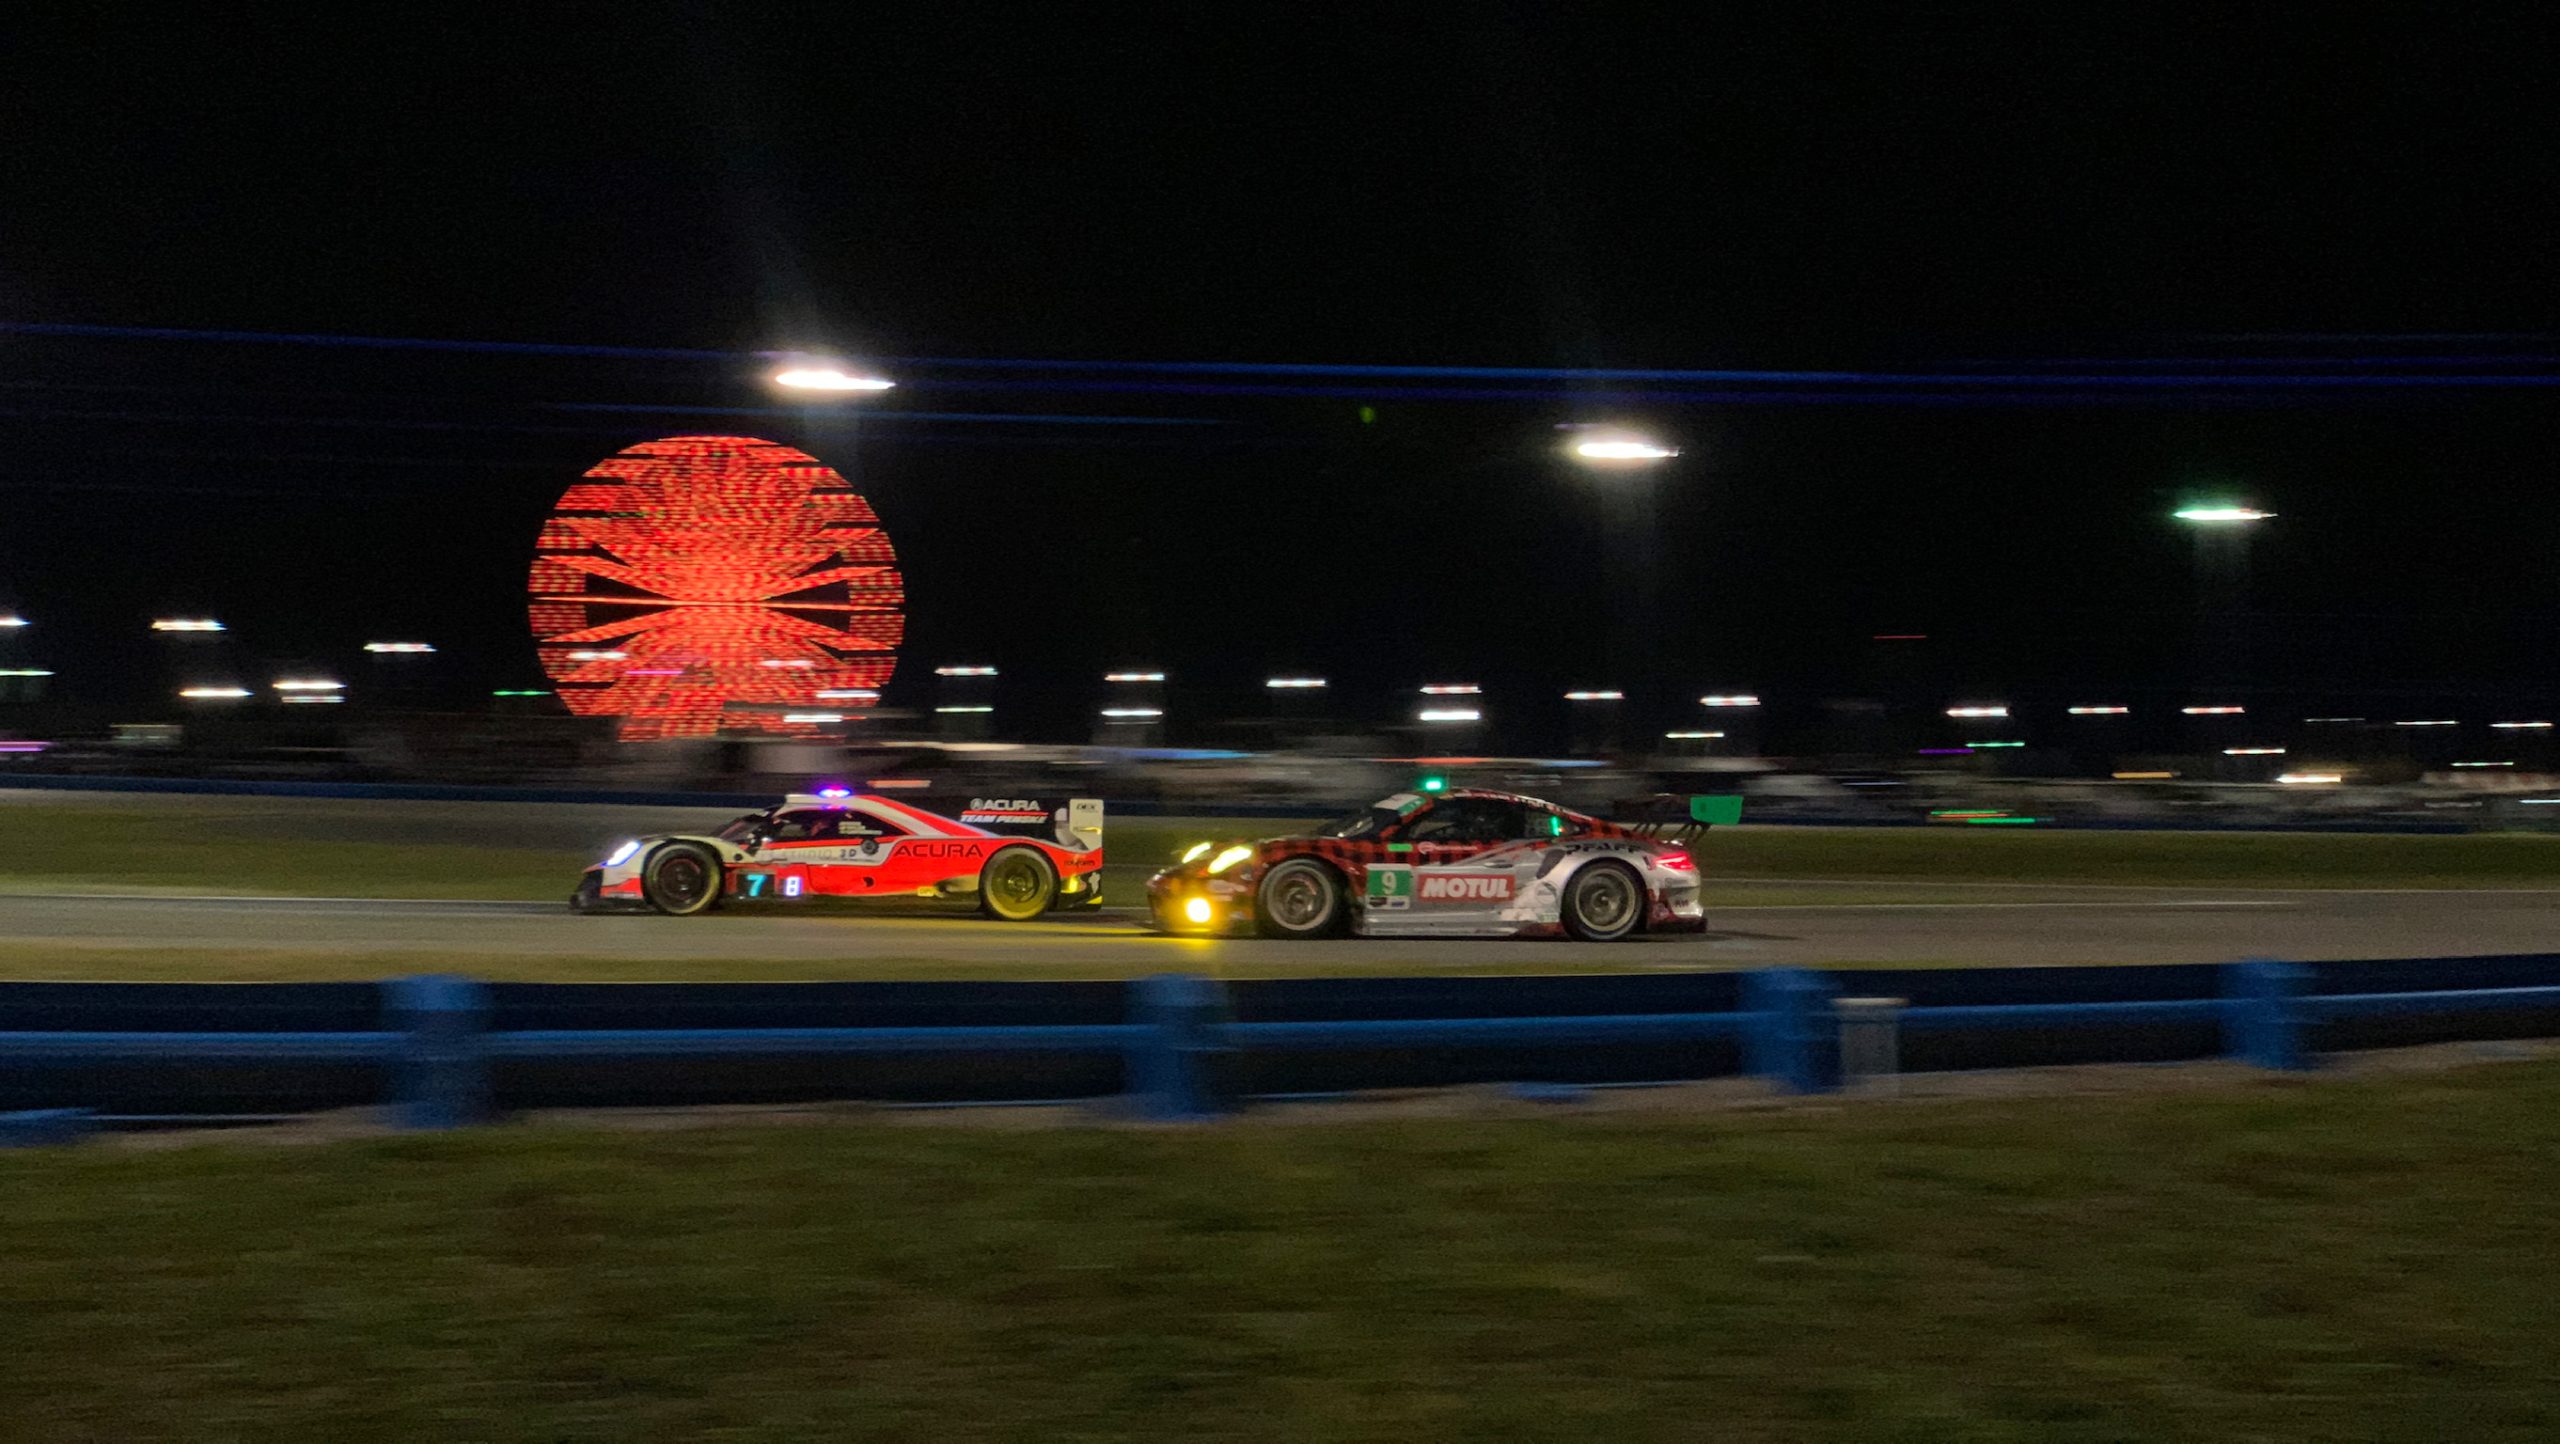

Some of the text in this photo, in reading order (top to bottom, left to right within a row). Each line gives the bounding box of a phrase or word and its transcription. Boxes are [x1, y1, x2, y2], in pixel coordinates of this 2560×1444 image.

[983, 799, 1041, 811] ACURA
[960, 815, 1048, 824] TEAM PENSKE
[895, 844, 983, 858] ACURA
[746, 874, 768, 897] 7
[785, 876, 802, 896] 8
[1381, 871, 1398, 895] 9
[1420, 877, 1511, 898] MOTUL
